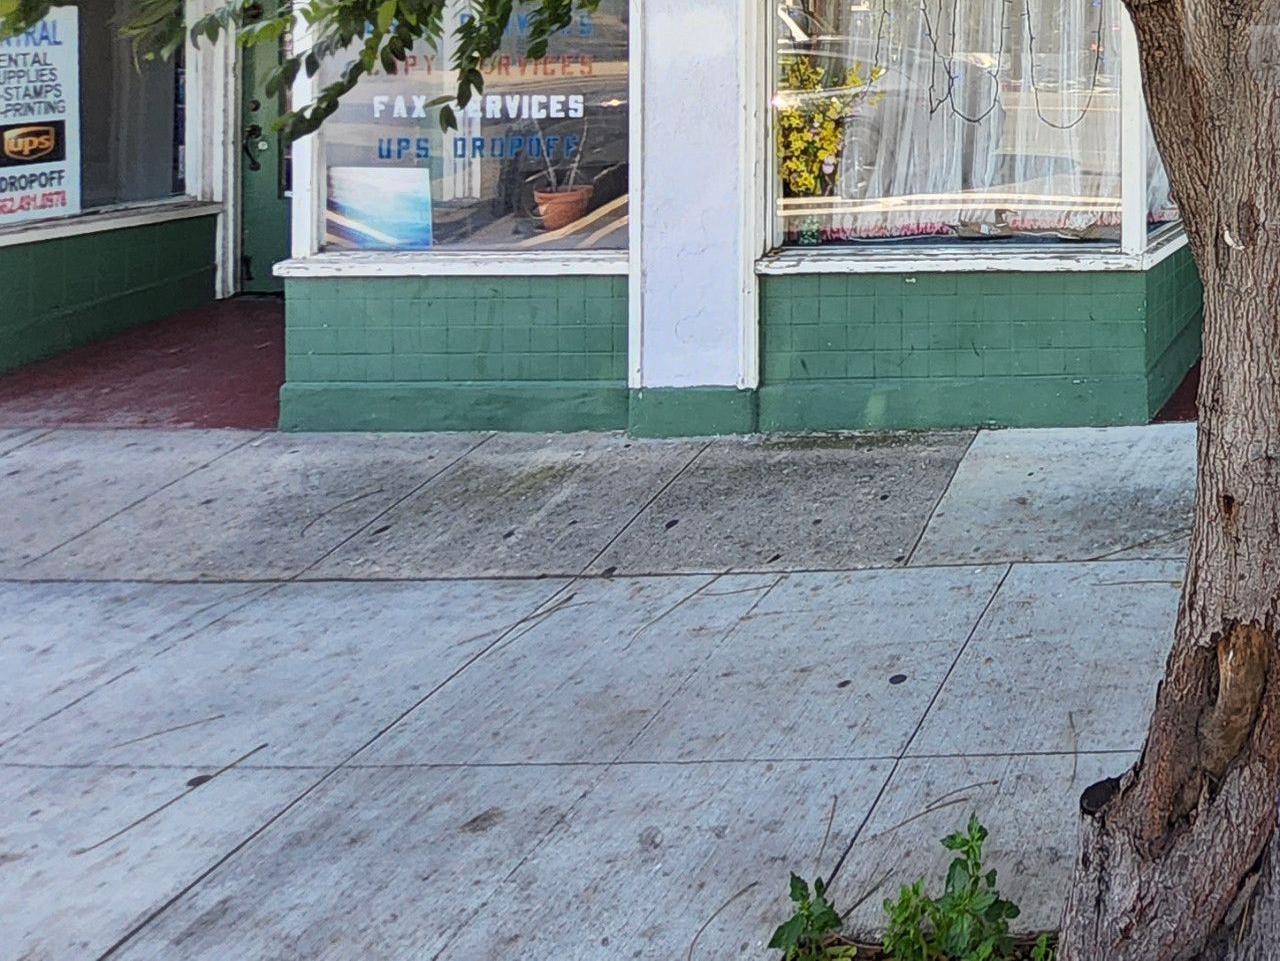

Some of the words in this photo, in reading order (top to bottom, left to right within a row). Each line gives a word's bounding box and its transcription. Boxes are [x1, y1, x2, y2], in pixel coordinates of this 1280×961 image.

[373, 94, 427, 119] FAX
[456, 94, 584, 119] ERVICES
[7, 134, 52, 156] ups
[377, 138, 430, 160] UPS
[453, 134, 578, 160] DROPOFF
